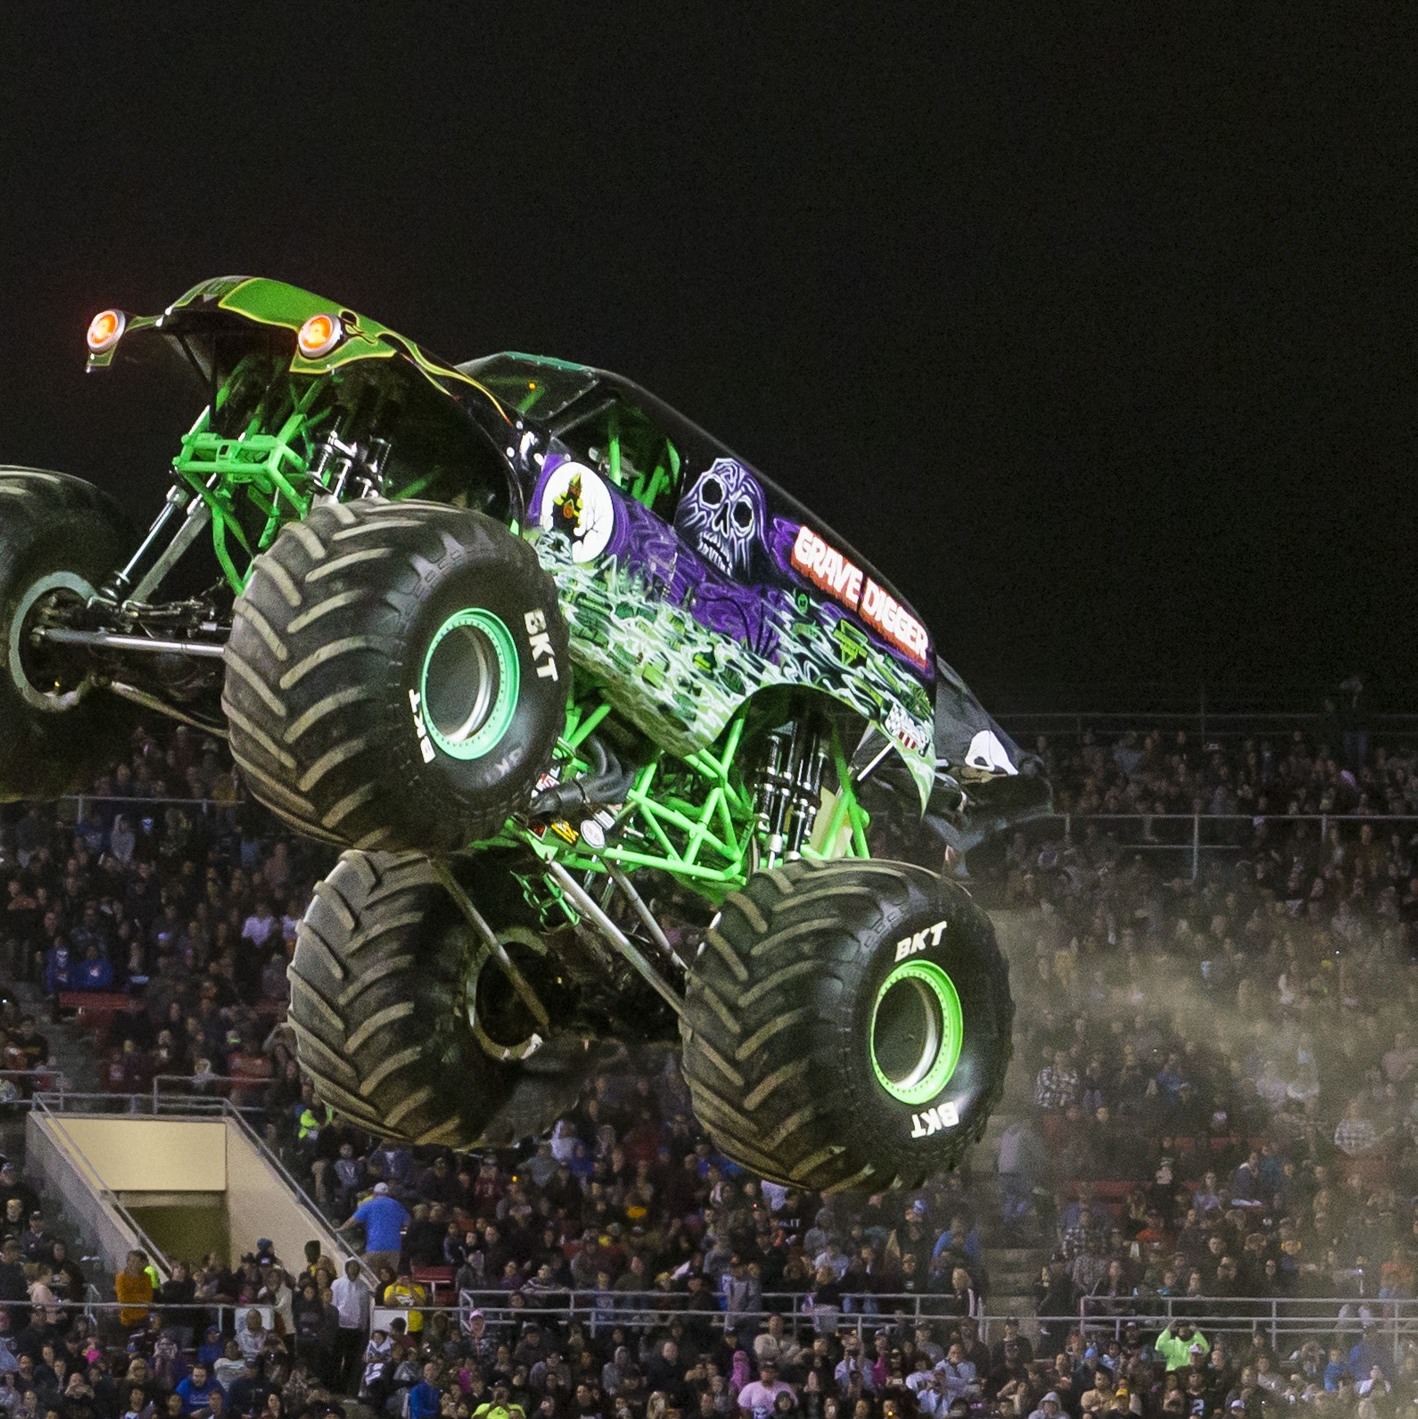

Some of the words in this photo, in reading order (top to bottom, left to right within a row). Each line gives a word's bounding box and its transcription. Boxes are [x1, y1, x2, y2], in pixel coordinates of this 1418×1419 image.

[792, 525, 863, 611] GRAVE
[860, 577, 930, 665] DIGGER
[524, 608, 559, 682] BKT
[408, 688, 436, 764] BKT
[894, 921, 947, 962] BKT
[911, 1102, 959, 1138] BKT
